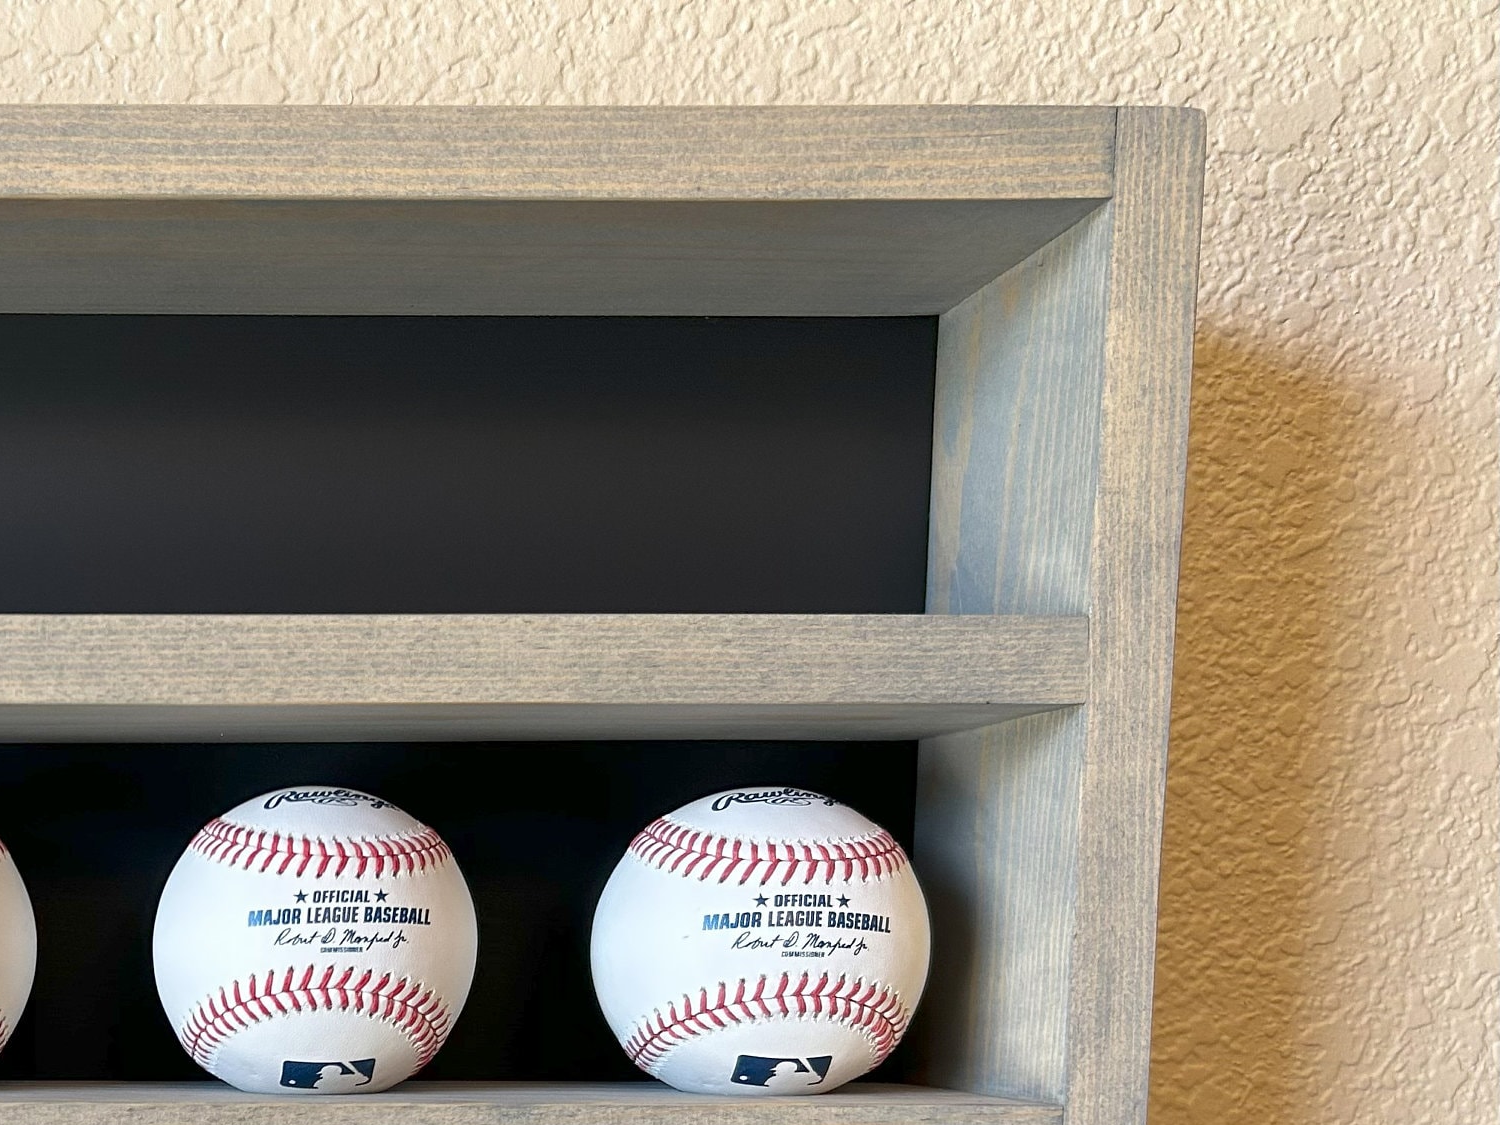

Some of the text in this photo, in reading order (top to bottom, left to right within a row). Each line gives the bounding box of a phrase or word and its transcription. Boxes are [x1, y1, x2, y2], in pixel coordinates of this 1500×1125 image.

[312, 890, 371, 903] OFFICIAL
[774, 894, 833, 908] OFFICIAL
[248, 906, 431, 927] MAJOR LEAGUE BASEBALL
[702, 910, 891, 933] MAJOR LEAGUE BASEBALL
